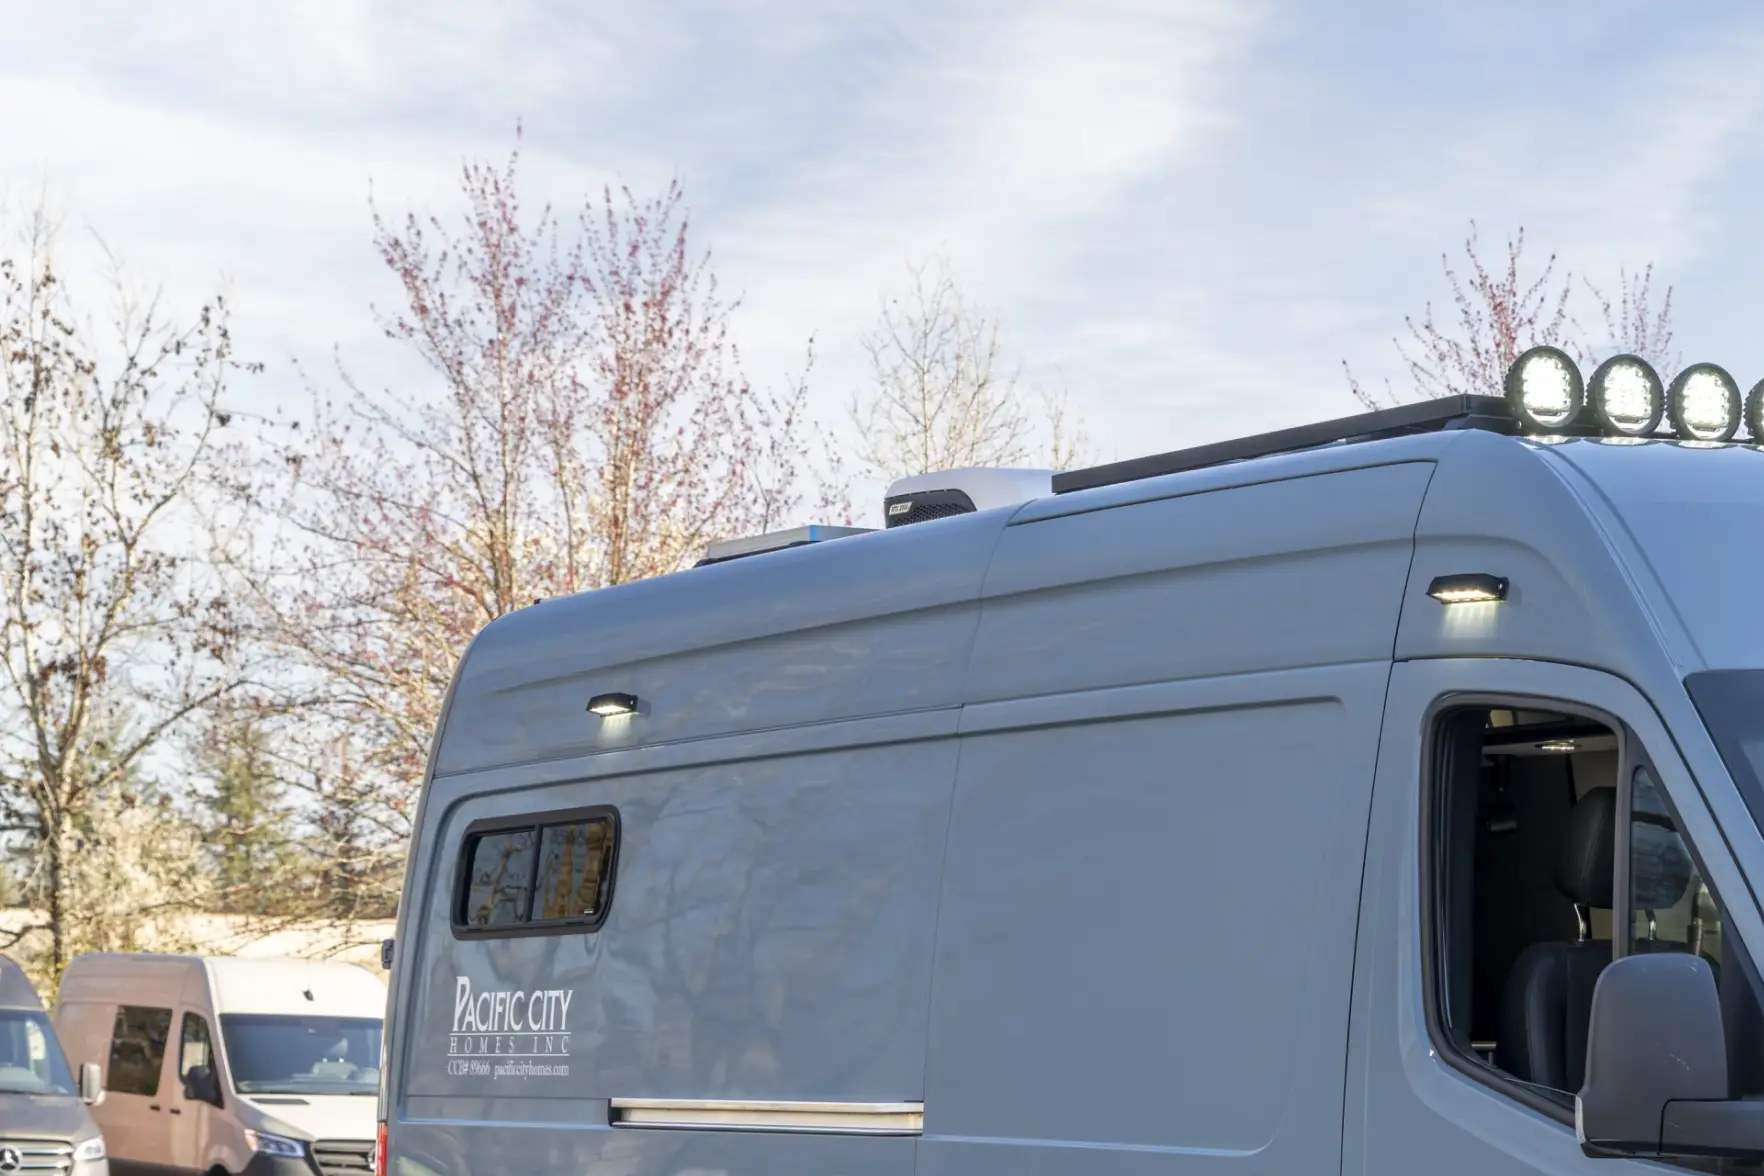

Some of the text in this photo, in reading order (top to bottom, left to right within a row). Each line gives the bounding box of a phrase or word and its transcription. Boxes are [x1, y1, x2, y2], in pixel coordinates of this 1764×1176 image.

[452, 976, 574, 1032] PACIFIC CITY
[449, 1036, 570, 1054] HOMES INC
[447, 1059, 469, 1076] CCB#
[494, 1059, 570, 1080] pacificcityhomes.com
